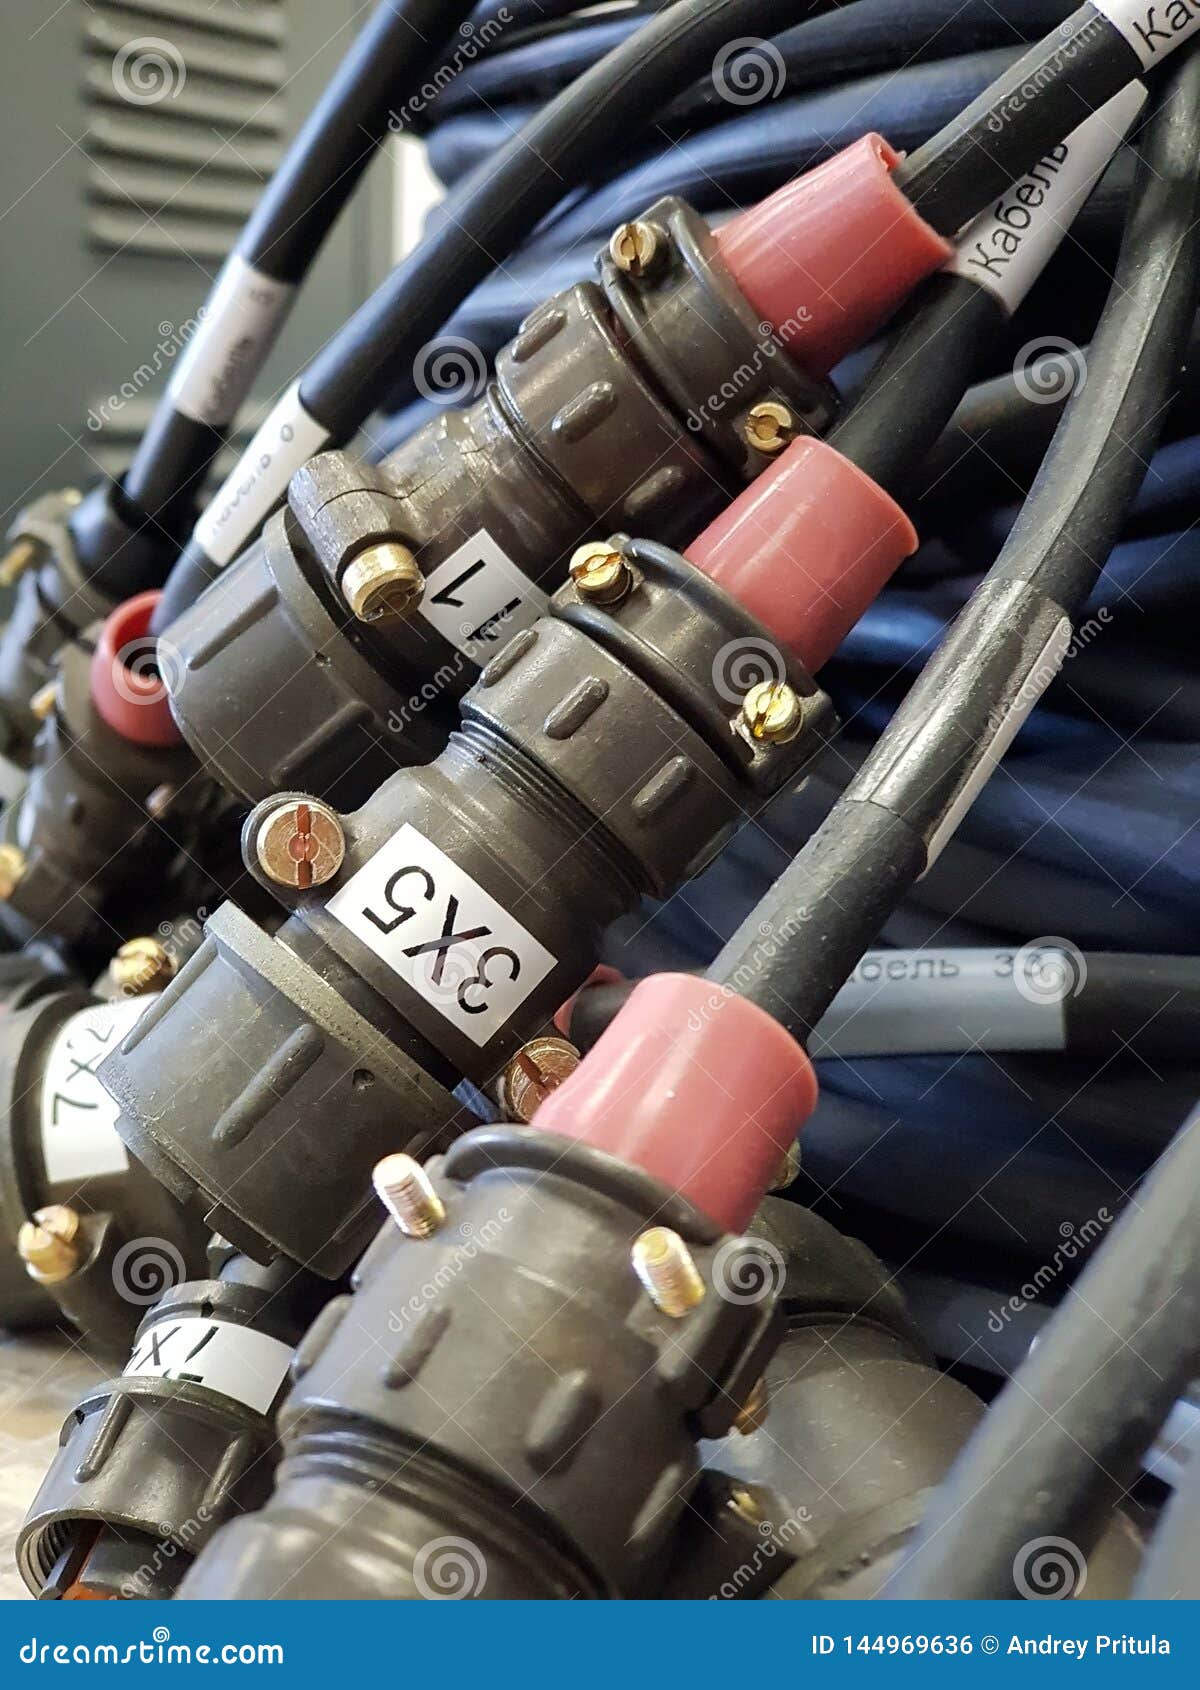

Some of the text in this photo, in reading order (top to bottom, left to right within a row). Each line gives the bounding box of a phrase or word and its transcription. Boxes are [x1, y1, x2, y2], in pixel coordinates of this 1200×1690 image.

[1132, 0, 1200, 52] Ка
[968, 143, 1069, 278] Кабель
[362, 865, 521, 1015] 3X5
